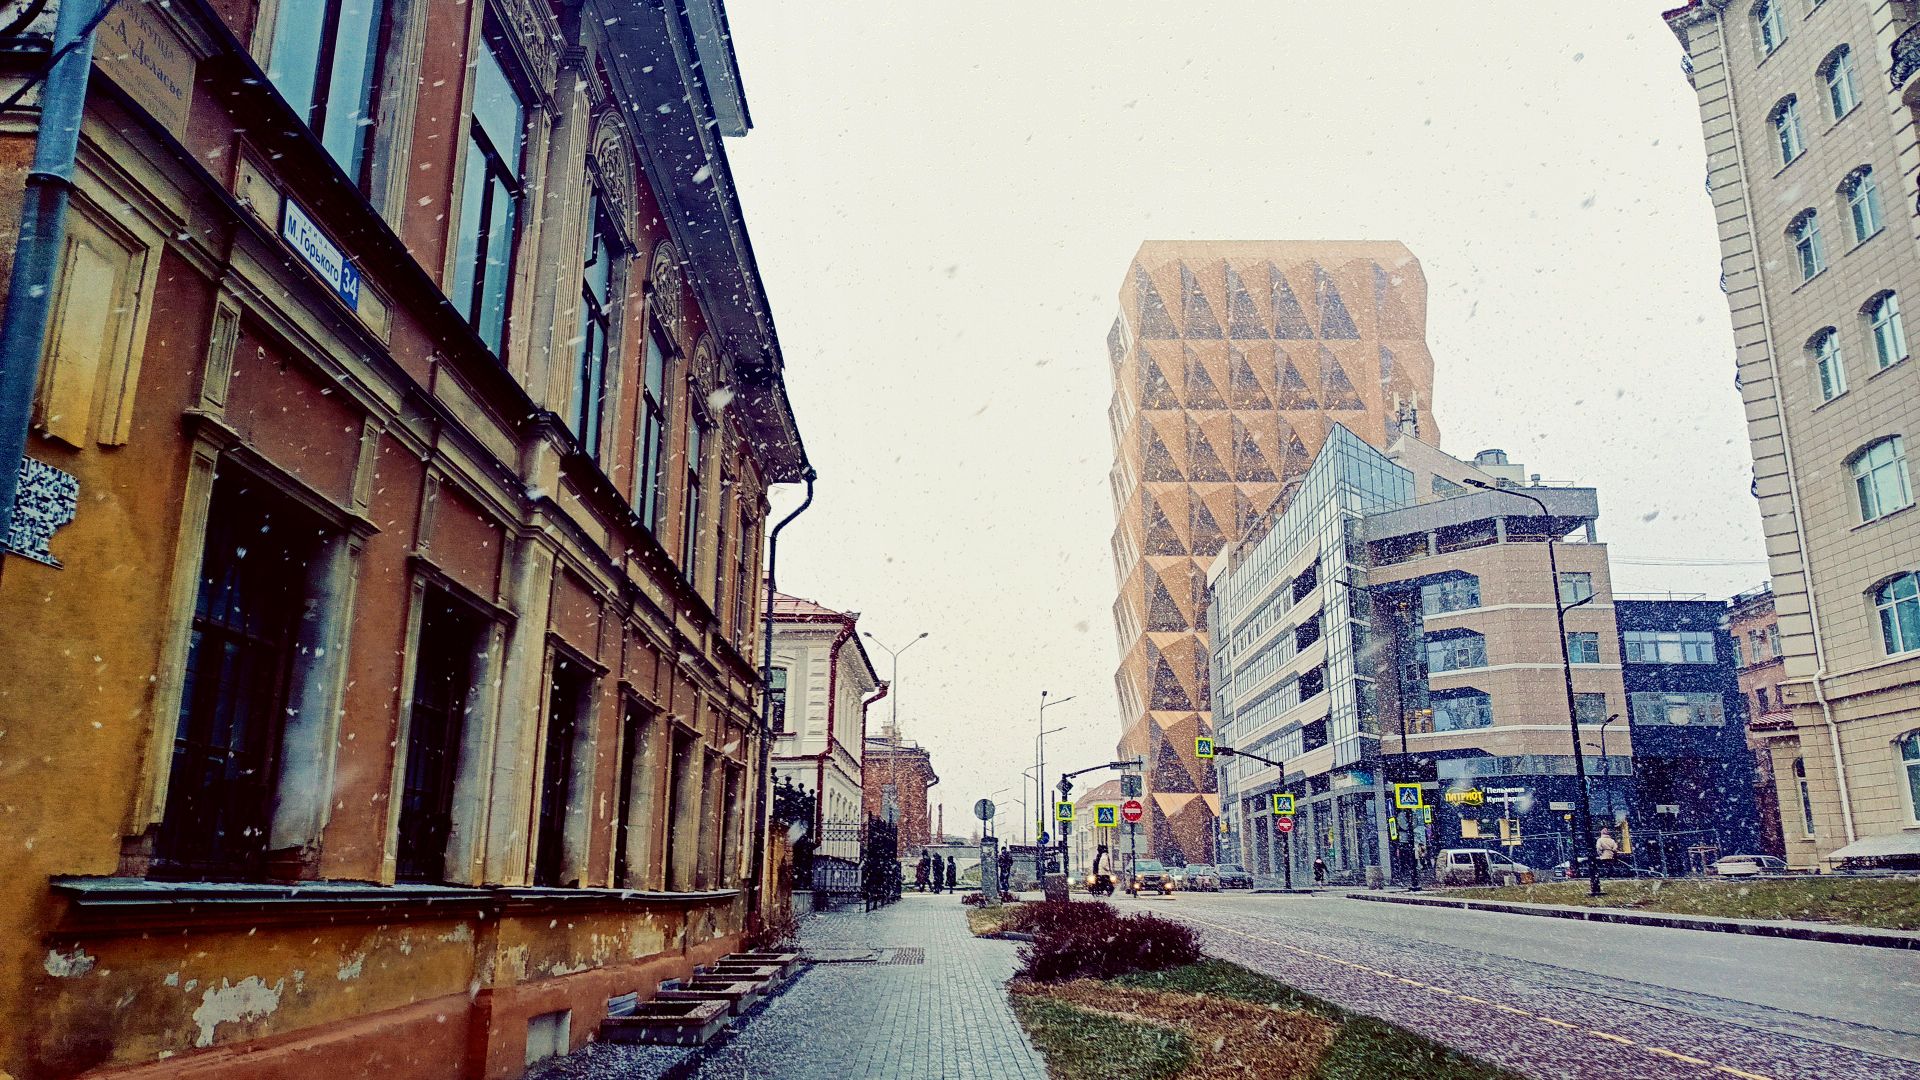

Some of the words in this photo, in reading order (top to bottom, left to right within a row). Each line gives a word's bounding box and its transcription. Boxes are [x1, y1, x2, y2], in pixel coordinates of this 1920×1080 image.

[300, 228, 339, 282] Горького
[343, 267, 358, 301] 34
[1445, 790, 1483, 802] ПАТРИОТ
